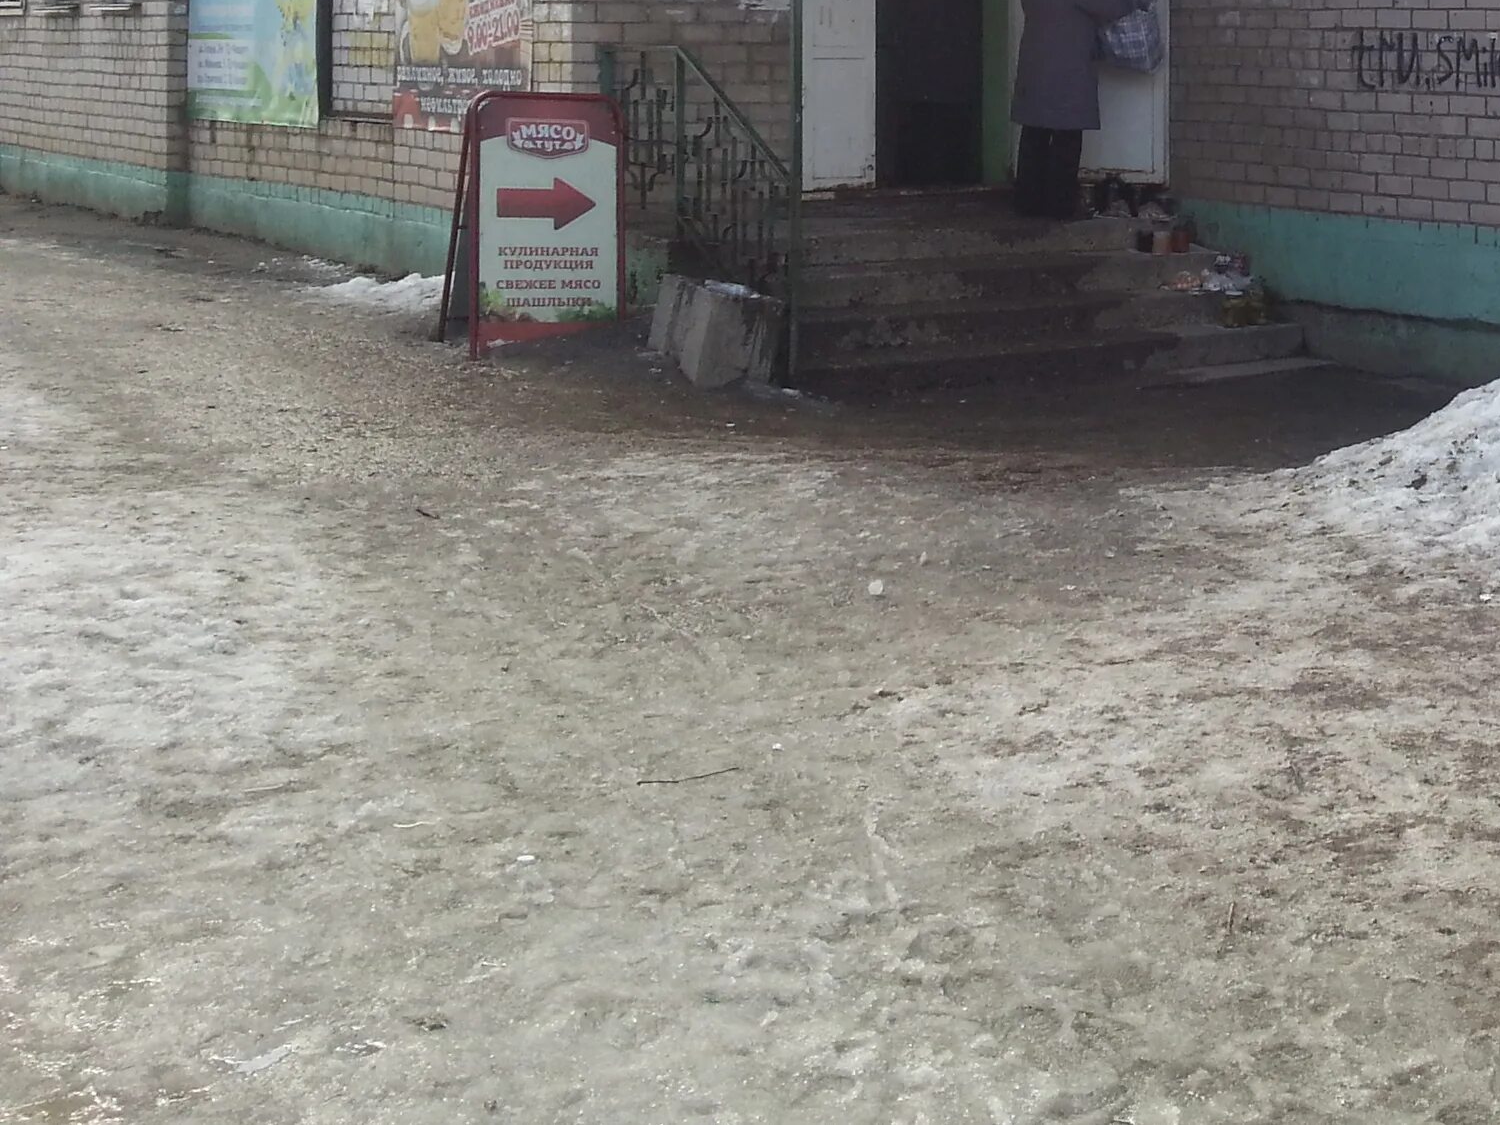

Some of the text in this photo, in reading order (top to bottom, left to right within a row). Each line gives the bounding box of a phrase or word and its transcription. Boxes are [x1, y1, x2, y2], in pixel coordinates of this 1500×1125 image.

[520, 124, 576, 139] МЯСО
[498, 246, 599, 257] КУЛИНАРНАЯ
[503, 260, 594, 271] ПРОДУКЦИЯ
[496, 279, 601, 290] СВЕЖЕЕ МЯСО
[506, 297, 592, 308] ШАШЛЫКИ
